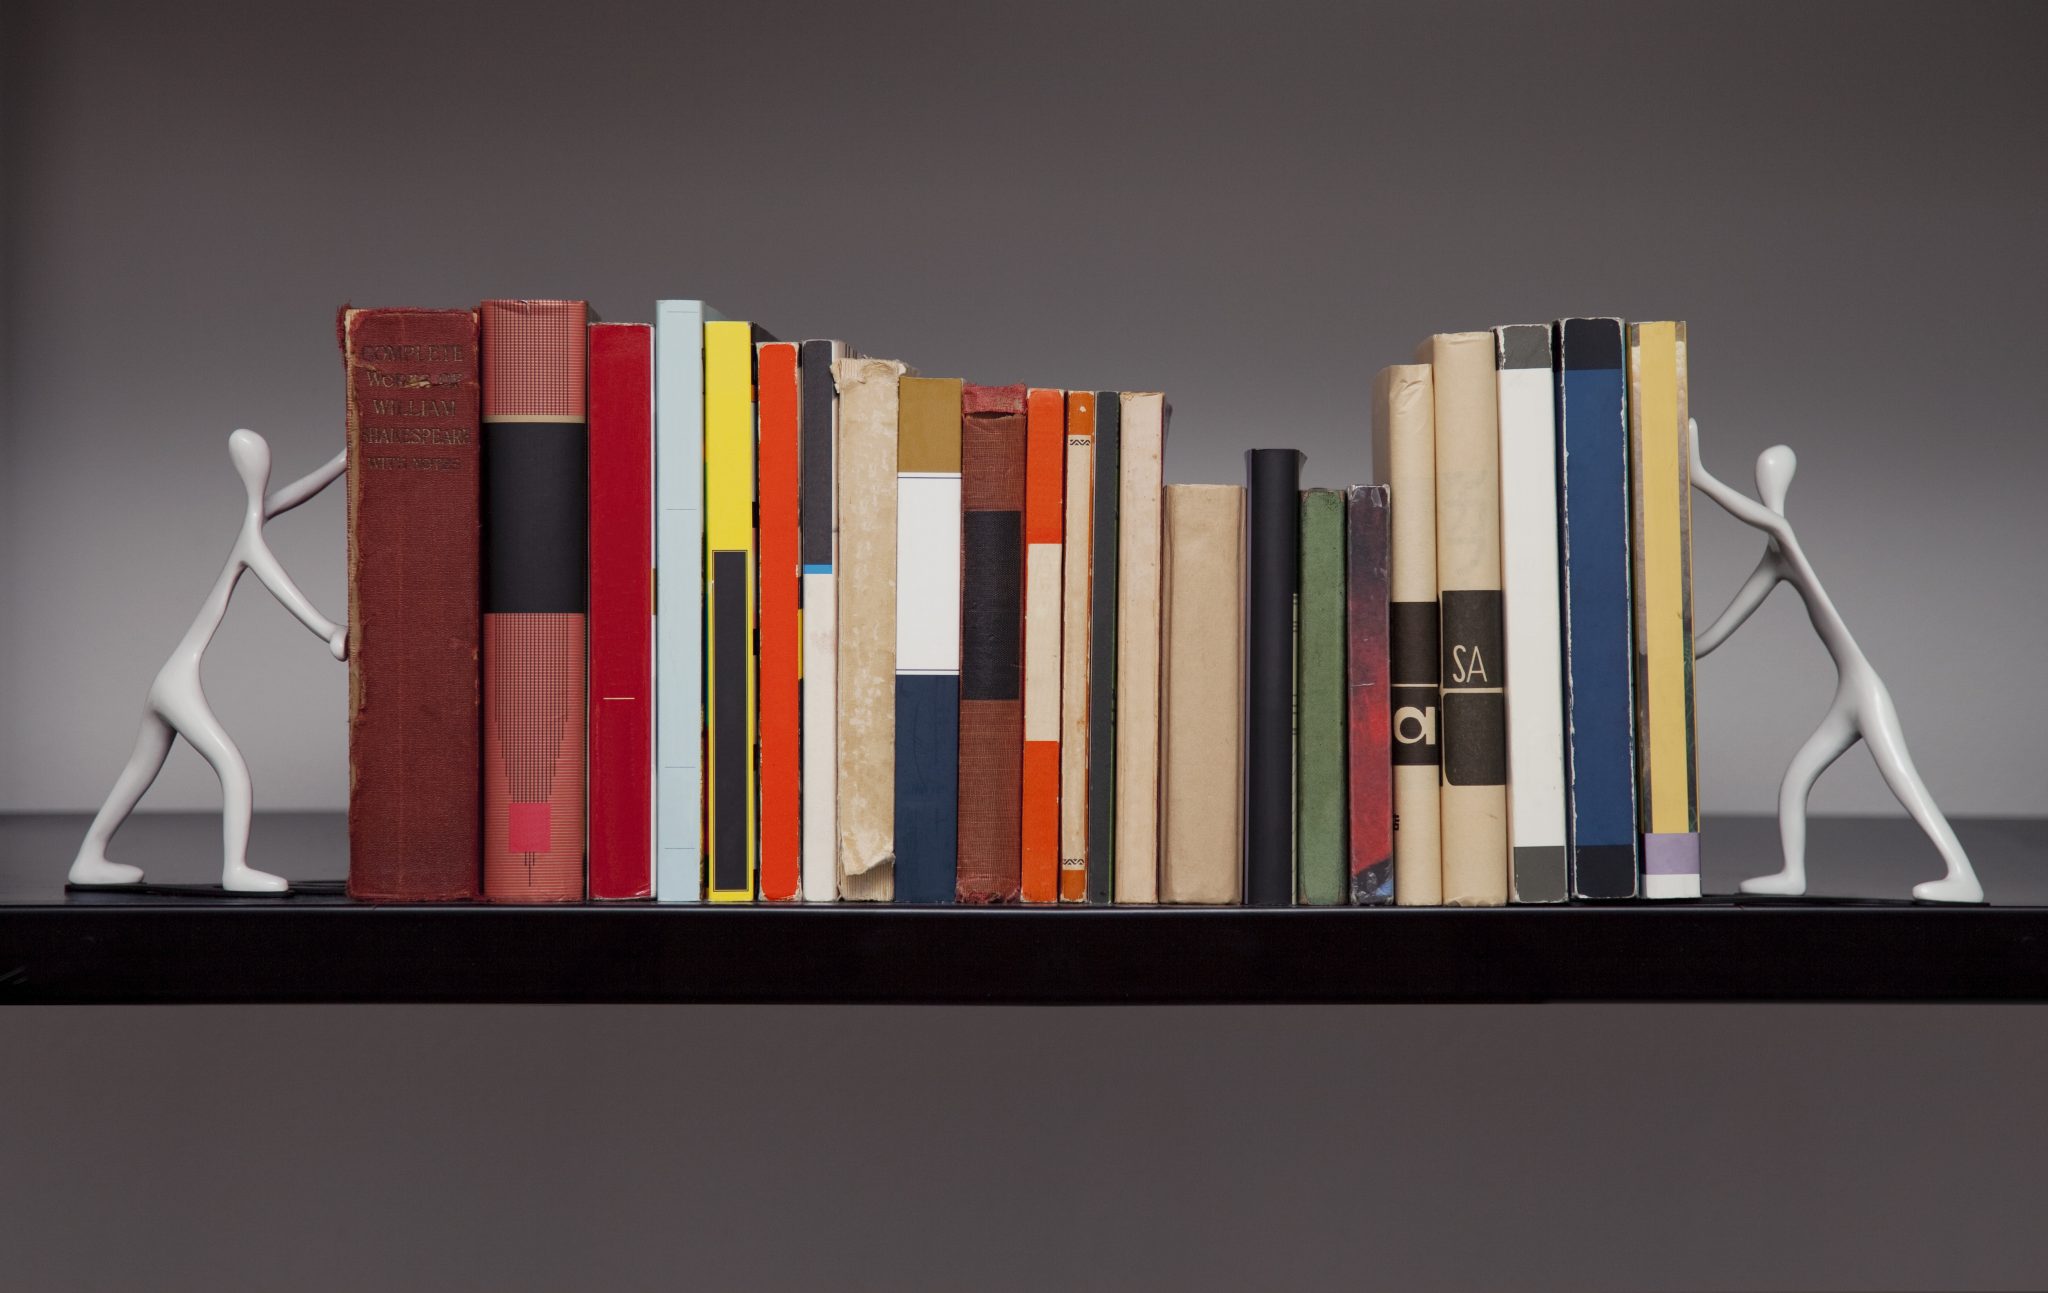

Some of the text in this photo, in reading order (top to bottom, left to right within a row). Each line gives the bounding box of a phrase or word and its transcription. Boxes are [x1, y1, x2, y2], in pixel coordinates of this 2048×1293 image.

[367, 370, 431, 388] WOR
[373, 399, 456, 417] WILLIAM
[1452, 644, 1488, 683] SA
